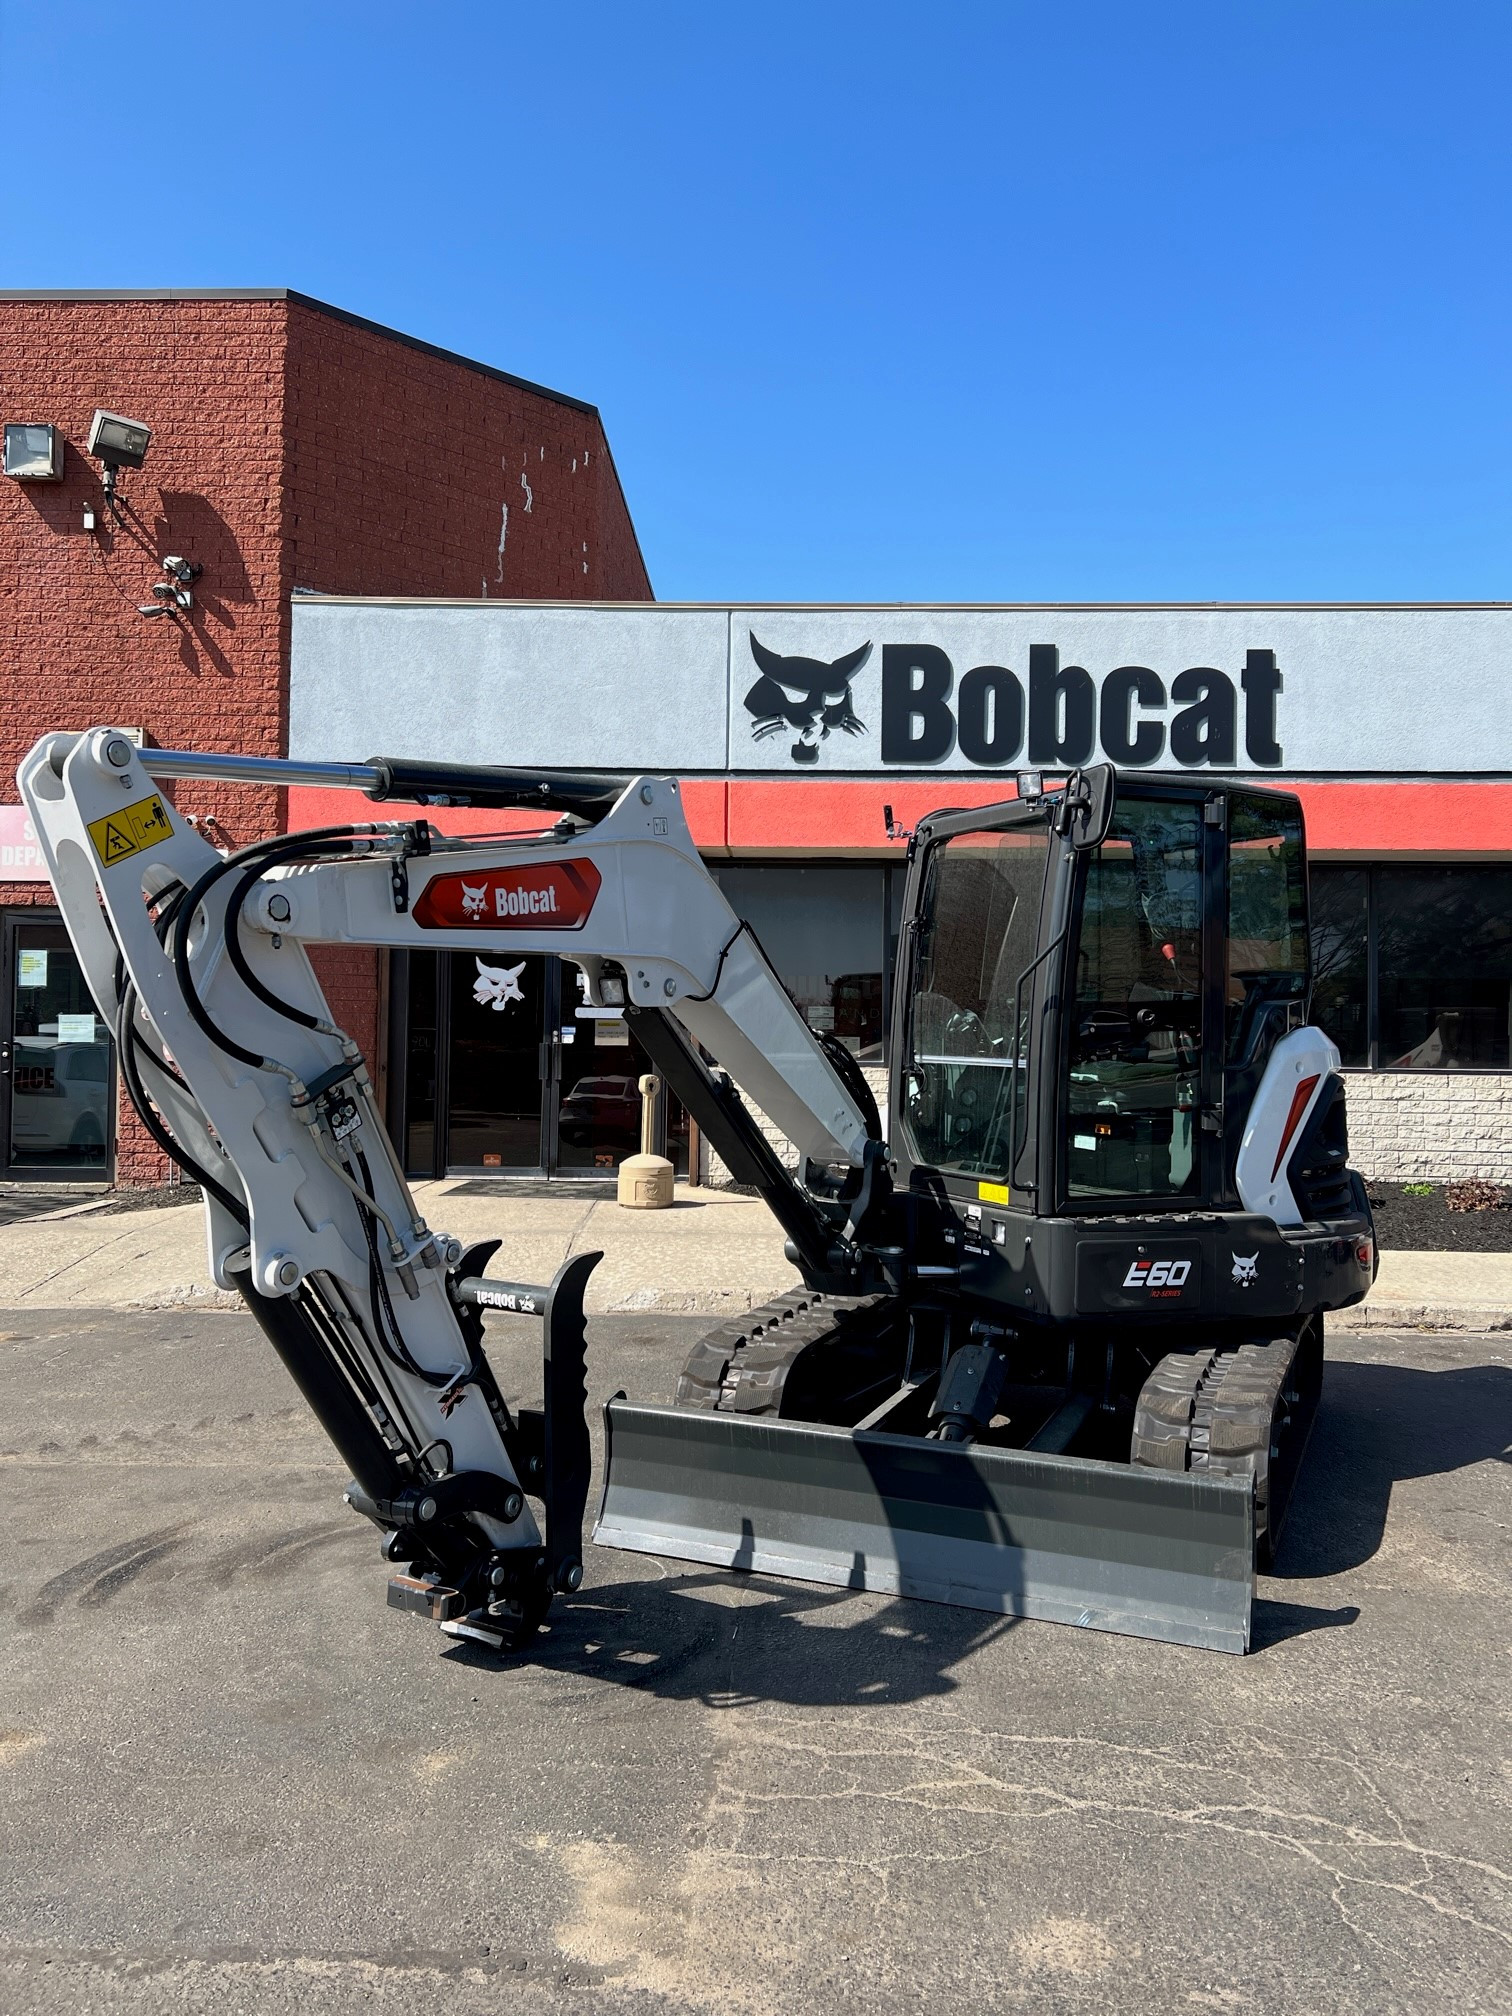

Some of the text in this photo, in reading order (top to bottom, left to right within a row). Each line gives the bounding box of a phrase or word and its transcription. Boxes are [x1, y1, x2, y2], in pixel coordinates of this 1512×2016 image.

[881, 644, 1282, 767] Bobcat
[495, 885, 557, 917] Bobcat
[1122, 1260, 1192, 1287] E60
[476, 1290, 517, 1310] Bobcat
